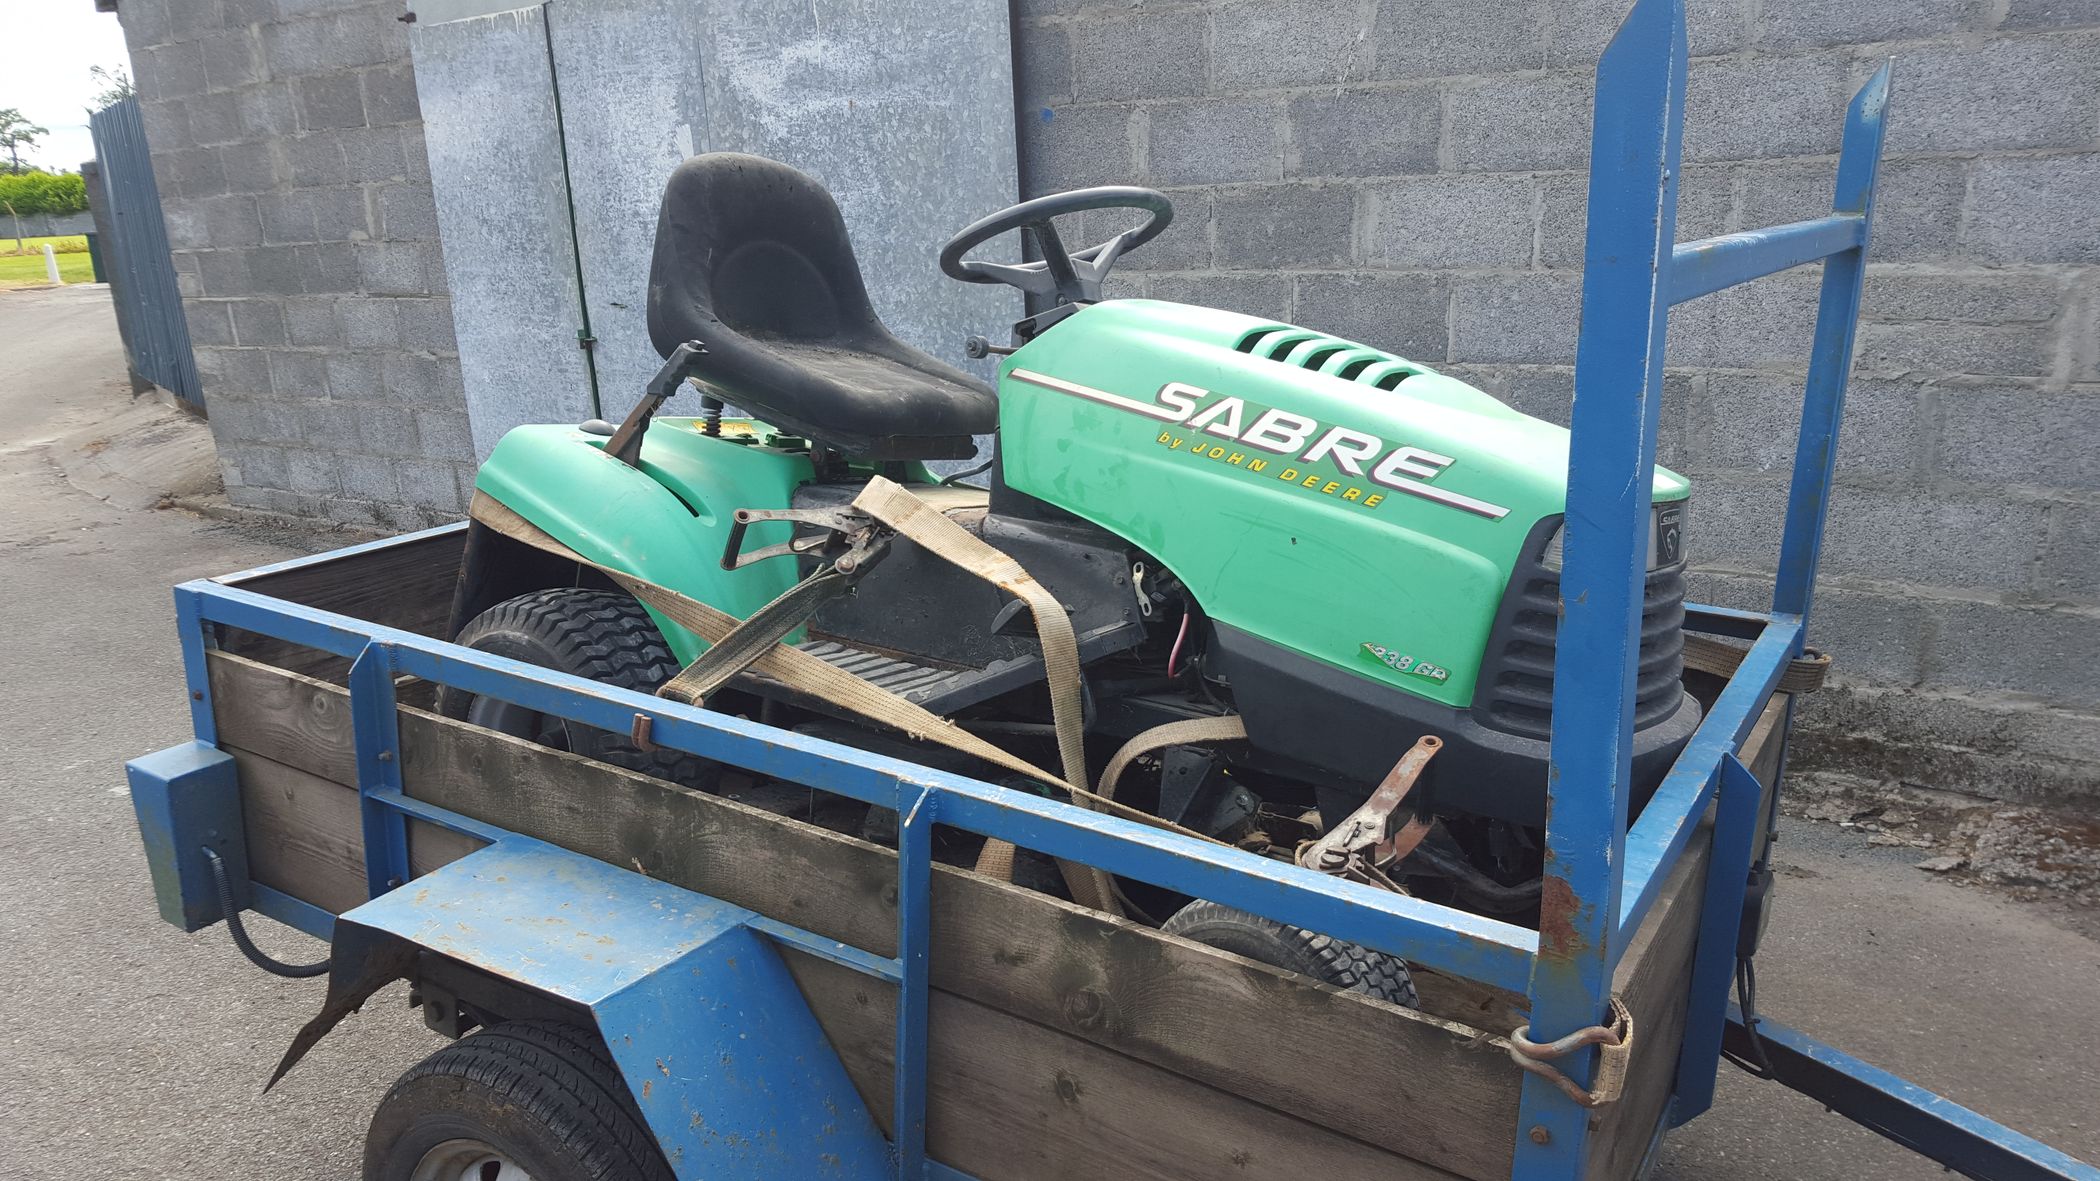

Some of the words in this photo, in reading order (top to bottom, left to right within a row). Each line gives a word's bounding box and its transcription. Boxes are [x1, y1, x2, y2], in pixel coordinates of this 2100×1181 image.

[1154, 381, 1510, 518] SABRE
[1156, 431, 1183, 450] by
[1190, 442, 1268, 472] JOHN
[1277, 468, 1385, 508] DEERE
